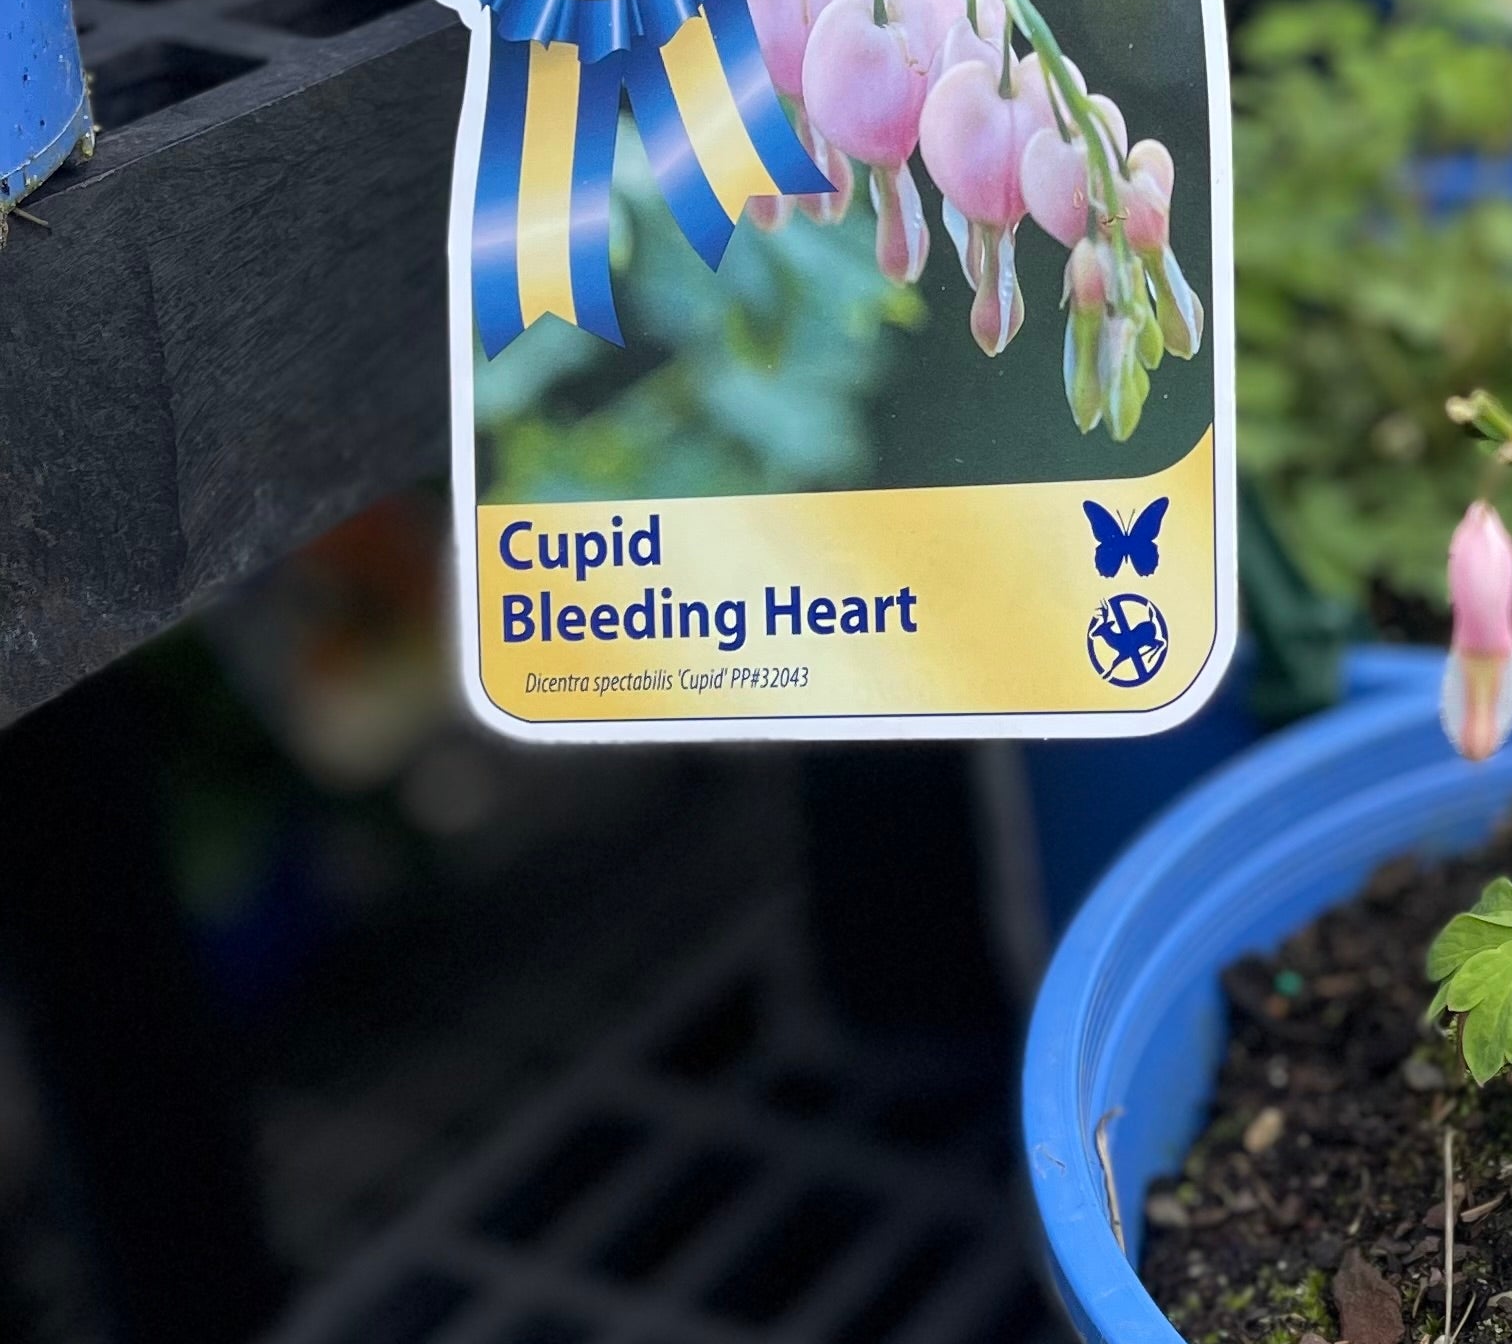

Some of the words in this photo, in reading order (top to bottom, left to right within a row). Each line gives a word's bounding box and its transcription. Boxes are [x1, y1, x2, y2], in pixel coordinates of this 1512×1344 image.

[499, 513, 661, 582] Cupid
[502, 587, 747, 652] Bleeding
[765, 586, 917, 636] Heart
[525, 672, 589, 694] Dicentra
[593, 668, 673, 696] spectabilis
[678, 668, 727, 695] 'Cupid'
[730, 666, 809, 689] PP#32043
